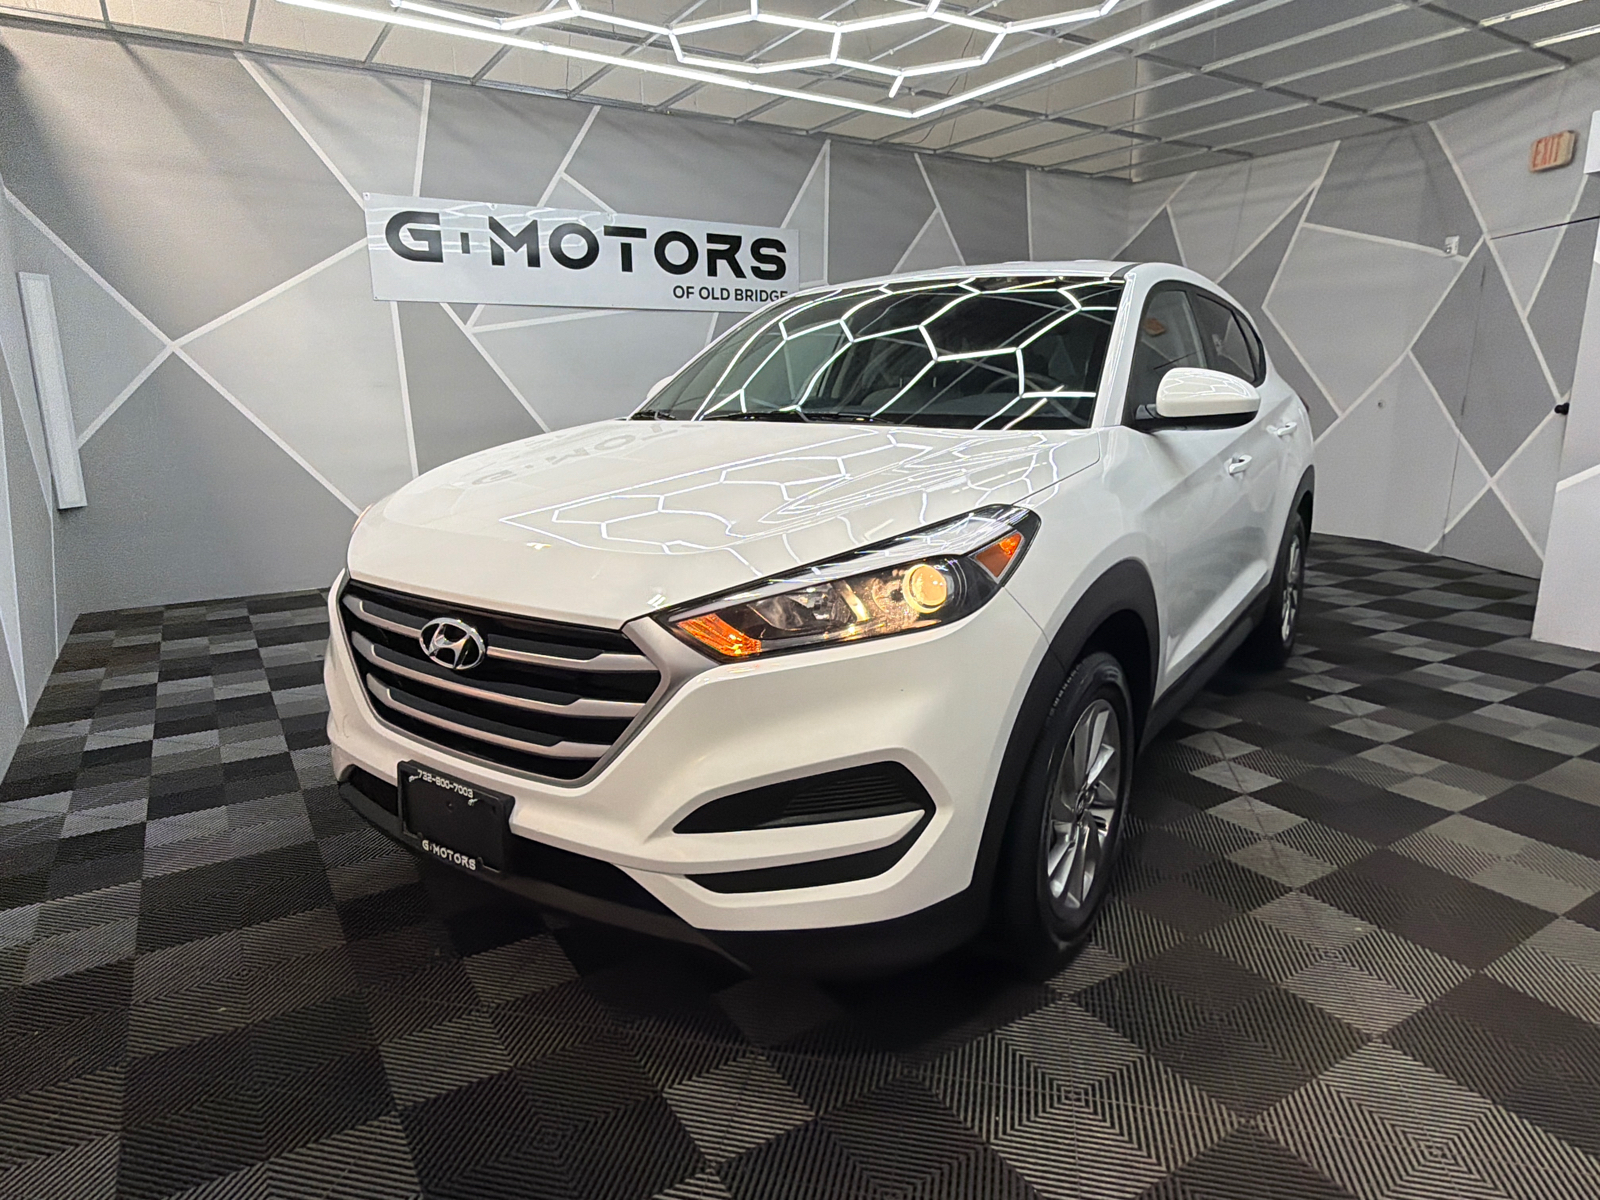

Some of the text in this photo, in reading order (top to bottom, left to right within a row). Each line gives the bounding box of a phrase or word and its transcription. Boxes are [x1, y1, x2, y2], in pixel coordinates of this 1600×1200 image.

[1532, 132, 1564, 170] EXIT
[673, 285, 695, 299] OF
[699, 286, 731, 301] OLD
[417, 769, 475, 798] 732-800-7003
